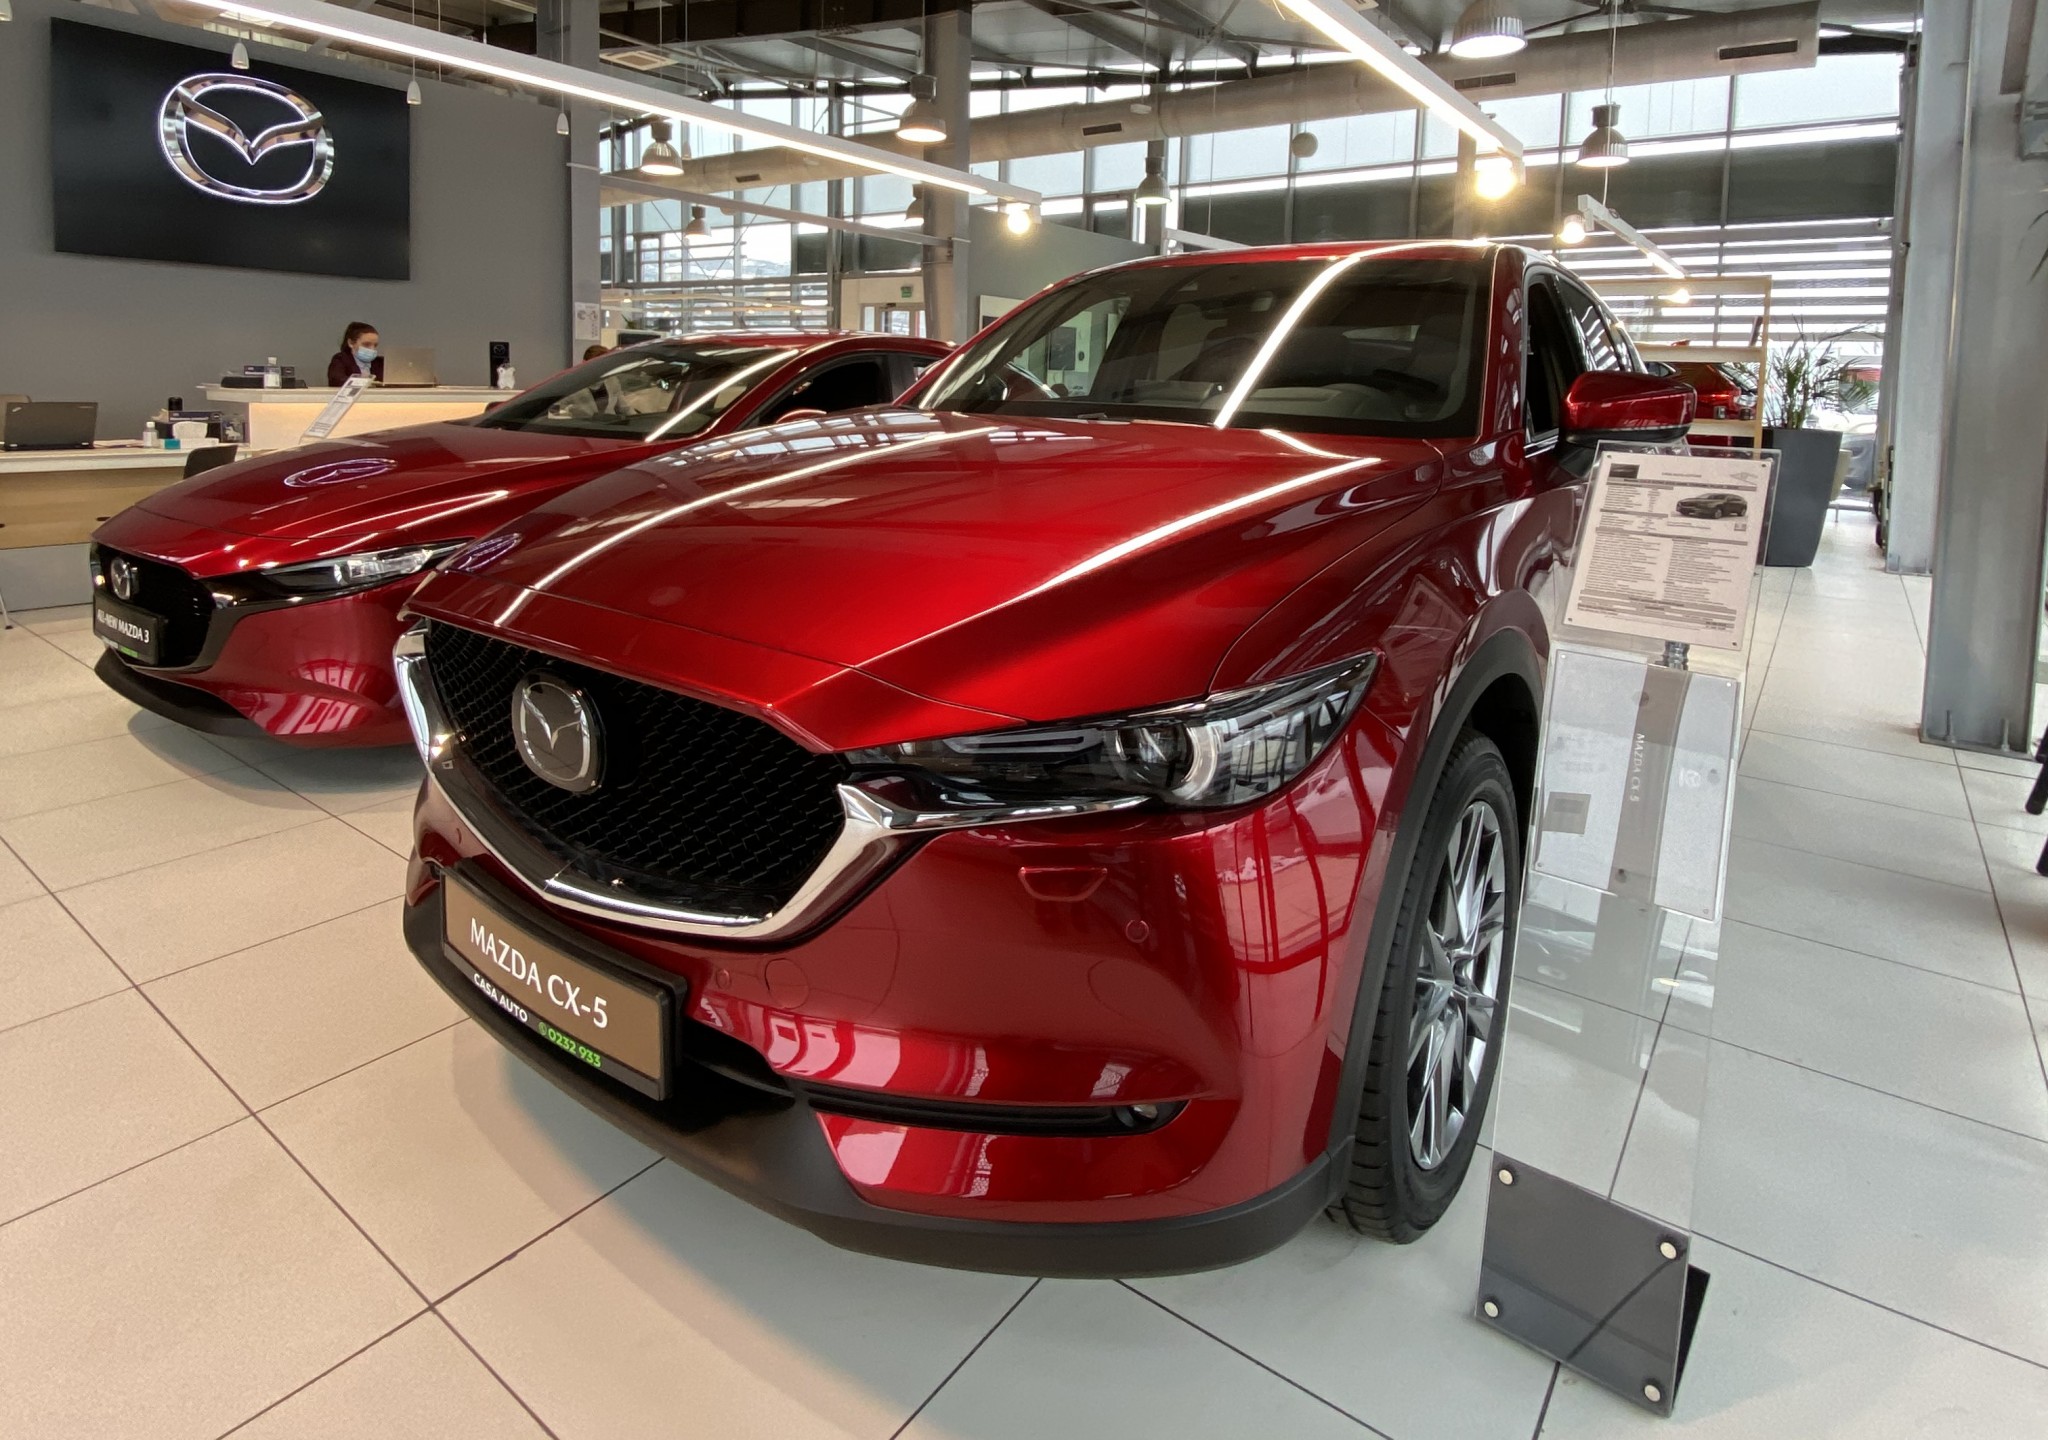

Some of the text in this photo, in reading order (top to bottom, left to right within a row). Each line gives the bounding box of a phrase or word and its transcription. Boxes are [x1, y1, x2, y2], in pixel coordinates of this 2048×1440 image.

[118, 619, 144, 641] MAZDA
[144, 630, 149, 643] 3
[1630, 733, 1645, 802] MAZDA CX-5
[470, 917, 608, 1029] MAZDA CX-5
[473, 973, 528, 1023] CASA AUTO
[548, 1028, 602, 1068] 0232 933
